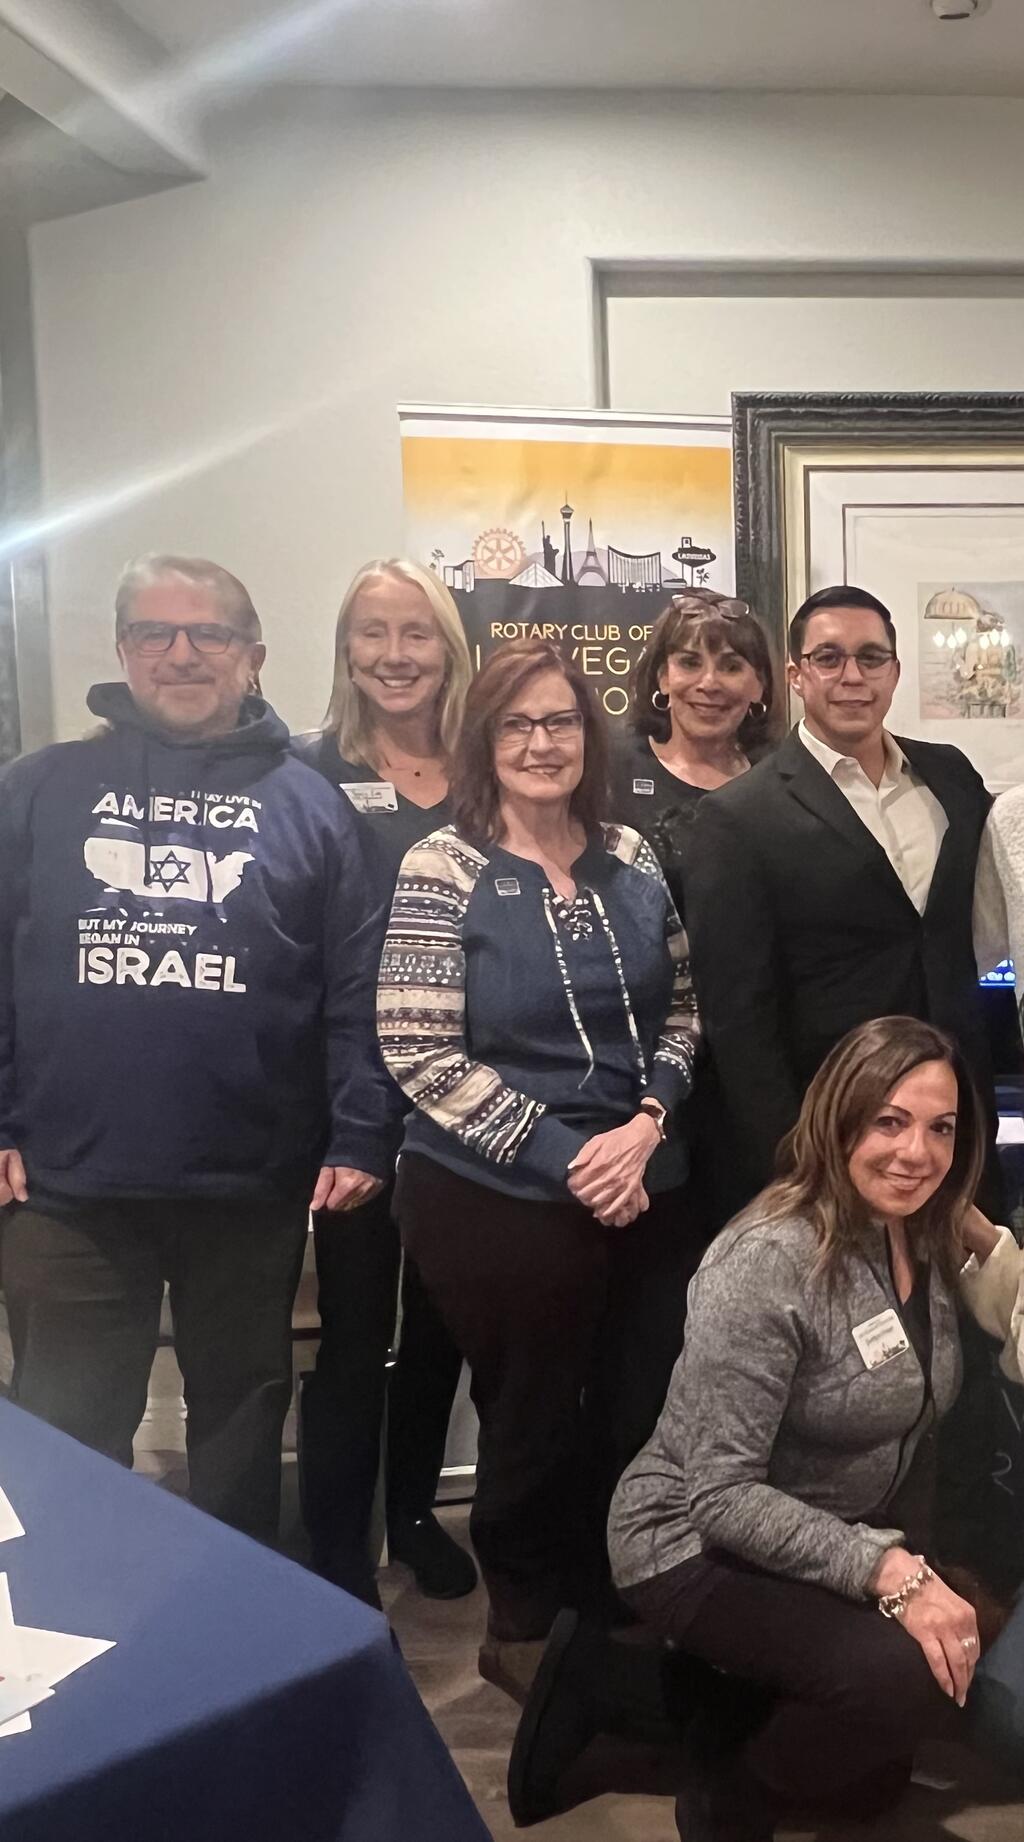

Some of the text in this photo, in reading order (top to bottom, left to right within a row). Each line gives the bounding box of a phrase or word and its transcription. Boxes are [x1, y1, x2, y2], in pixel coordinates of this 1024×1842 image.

[490, 622, 654, 641] ROTARY CLUB OF
[92, 792, 260, 833] AMERICA
[103, 919, 127, 930] MY
[130, 921, 198, 936] JOURNEY
[124, 934, 140, 946] IN
[78, 947, 247, 993] ISRAEL
